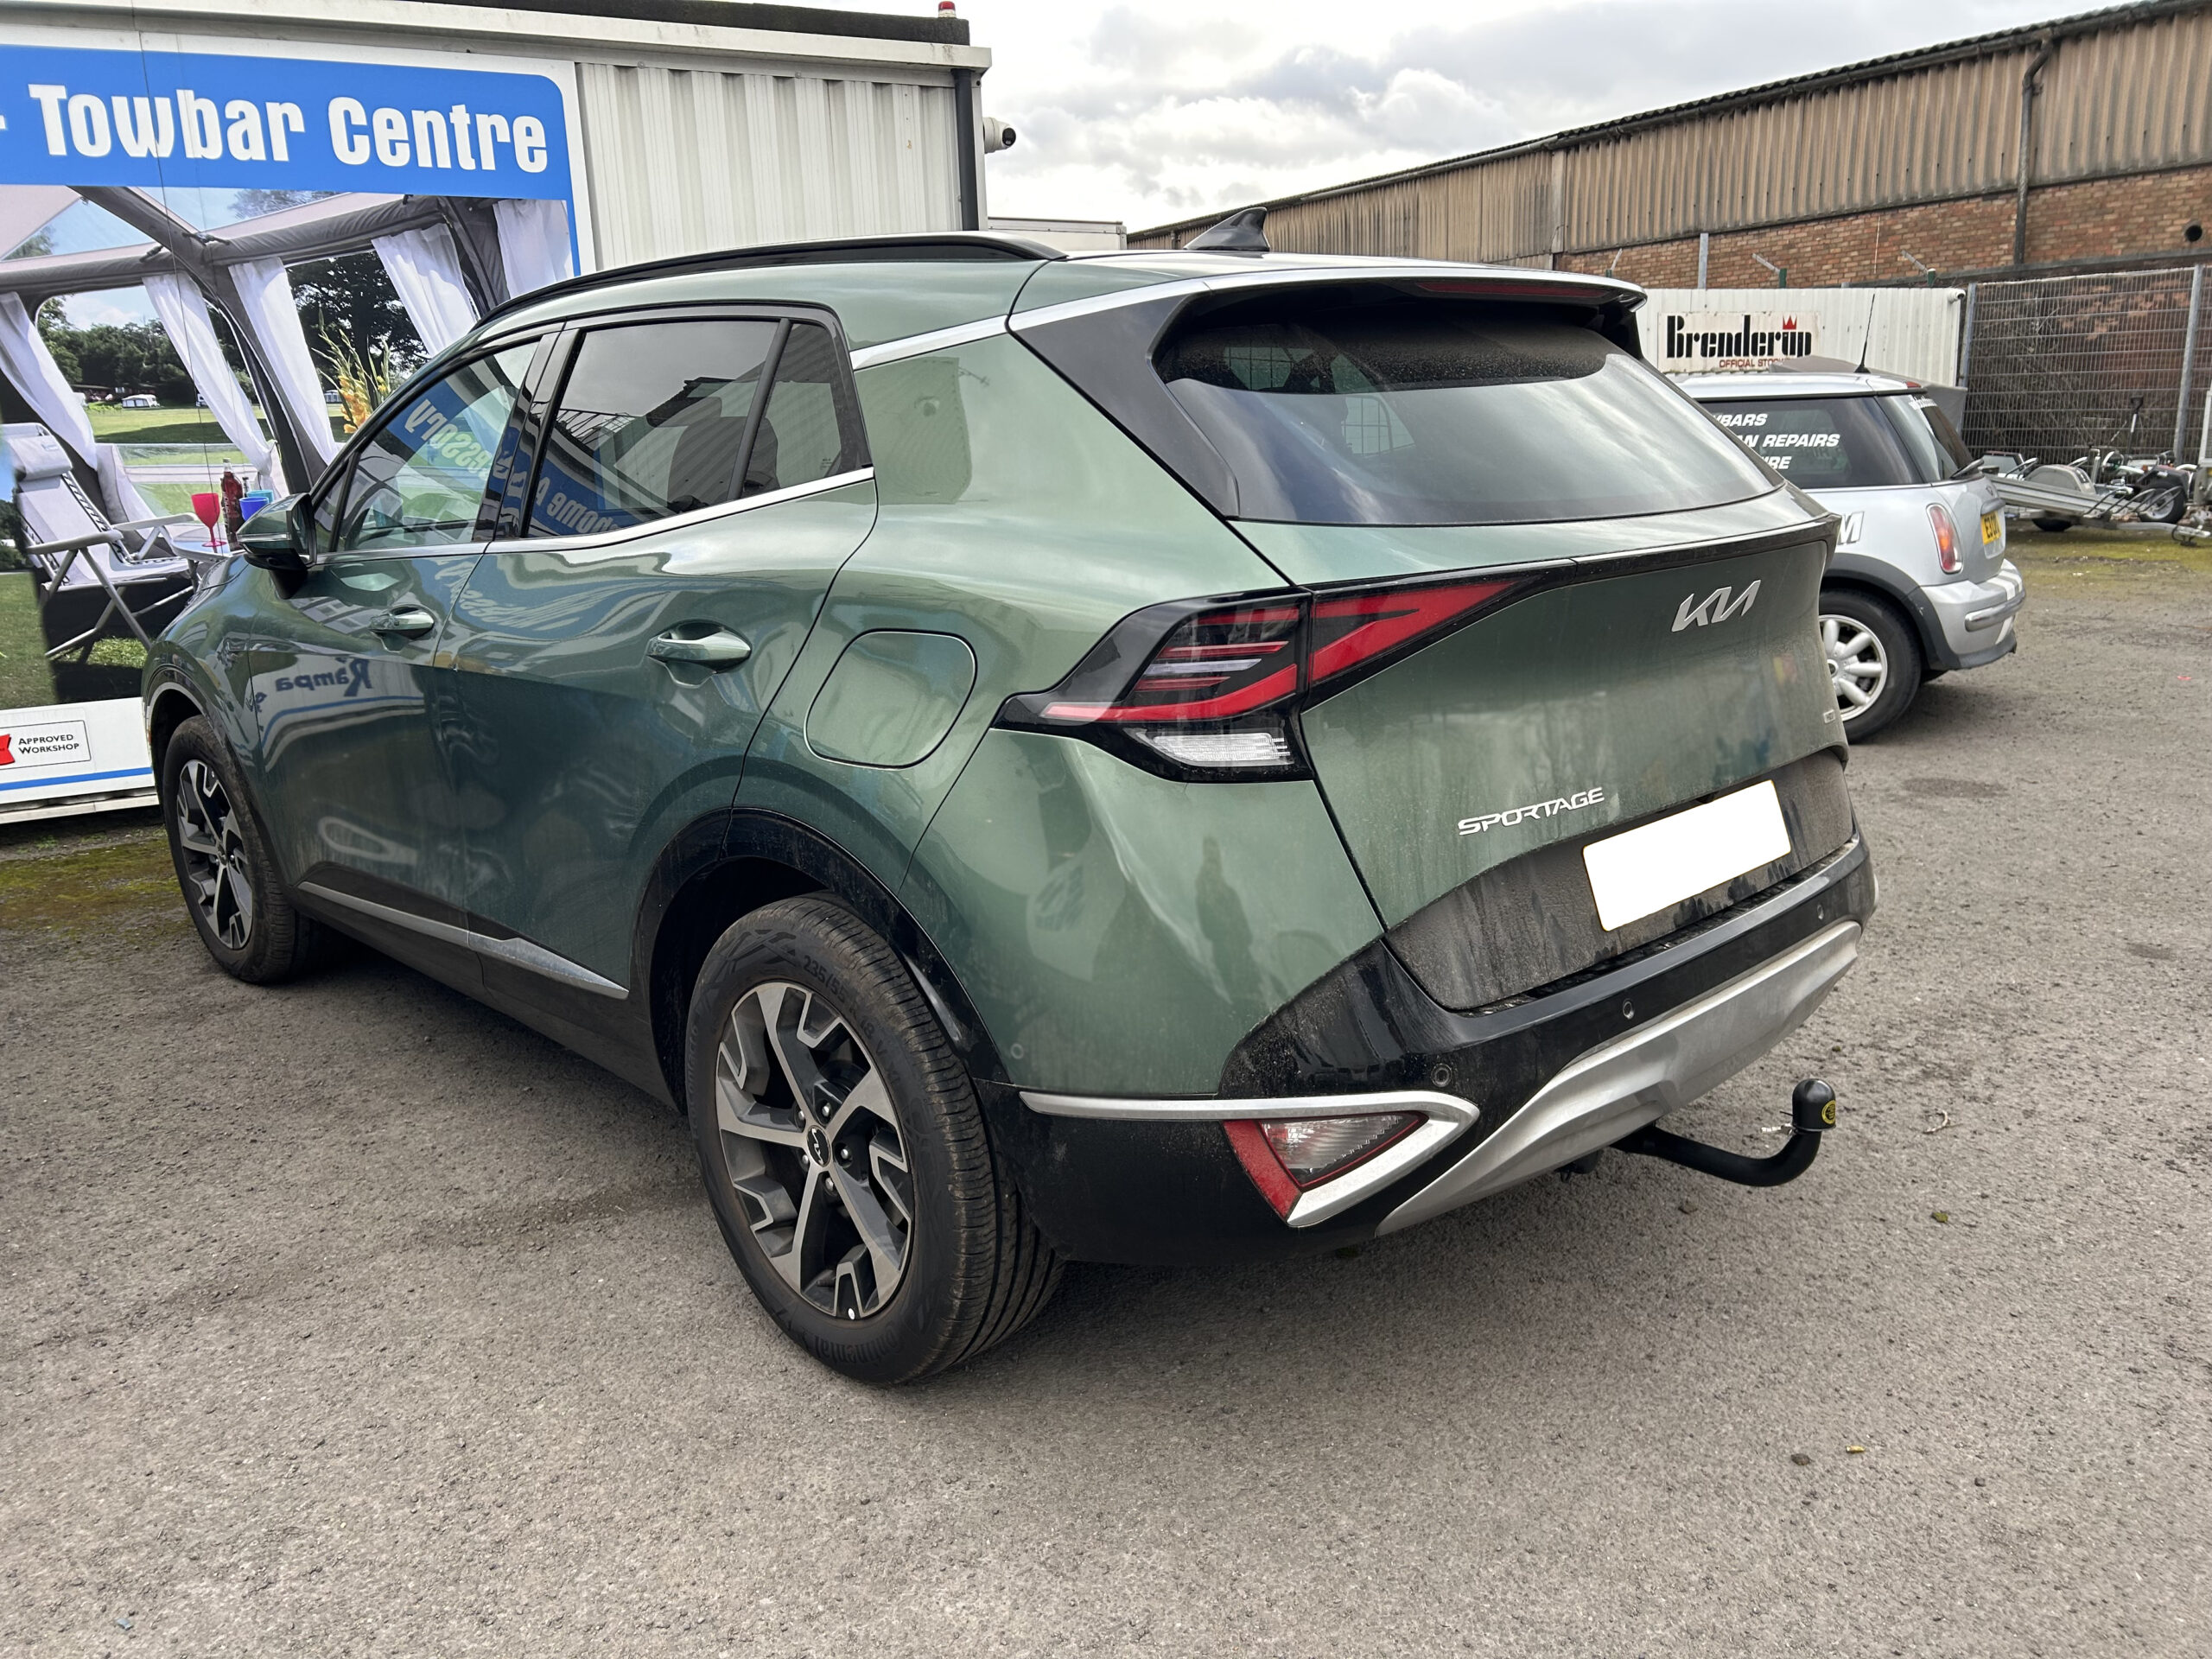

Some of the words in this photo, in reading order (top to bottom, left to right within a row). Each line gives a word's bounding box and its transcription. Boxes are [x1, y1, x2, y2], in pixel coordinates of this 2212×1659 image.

[28, 84, 305, 162] Towbar
[327, 96, 548, 174] Centre
[1667, 315, 1812, 358] Brenderup
[1719, 359, 1755, 369] OFFICIAL
[1714, 413, 1768, 427] BARS
[1763, 434, 1840, 448] REPAIRS
[18, 734, 73, 745] APPROVED
[18, 743, 79, 754] WORKSHOP
[1458, 786, 1605, 836] SPORTAGE
